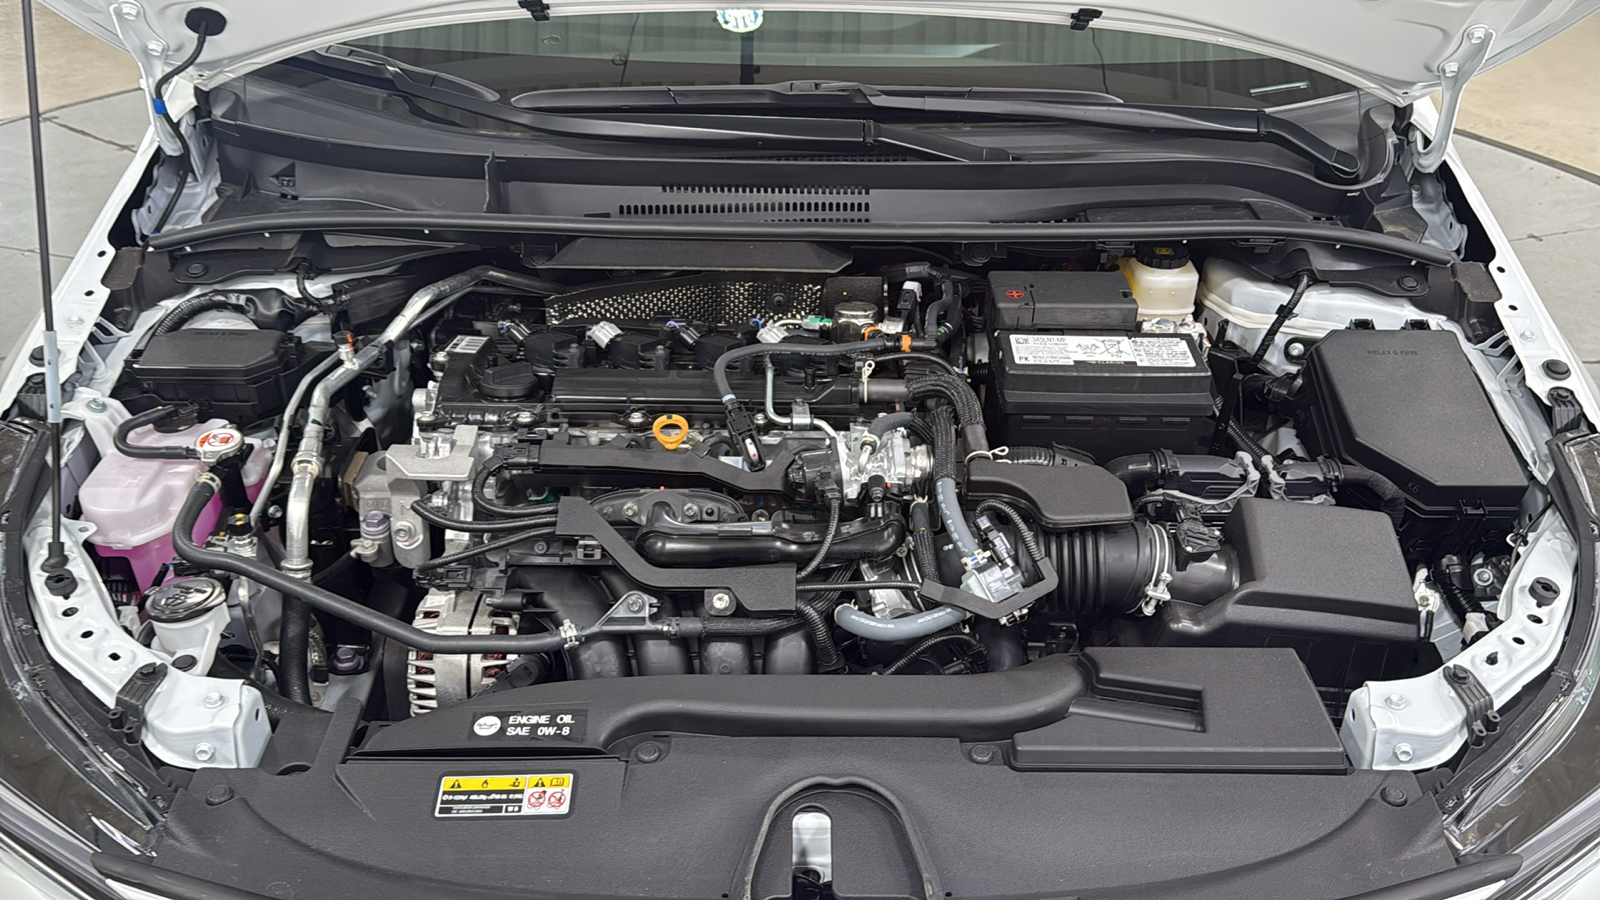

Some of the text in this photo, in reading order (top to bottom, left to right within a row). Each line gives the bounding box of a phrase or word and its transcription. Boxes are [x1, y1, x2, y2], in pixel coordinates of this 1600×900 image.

[1406, 480, 1421, 494] K6
[508, 714, 575, 725] ENGINE OIL
[505, 726, 570, 736] SAE 0W-8
